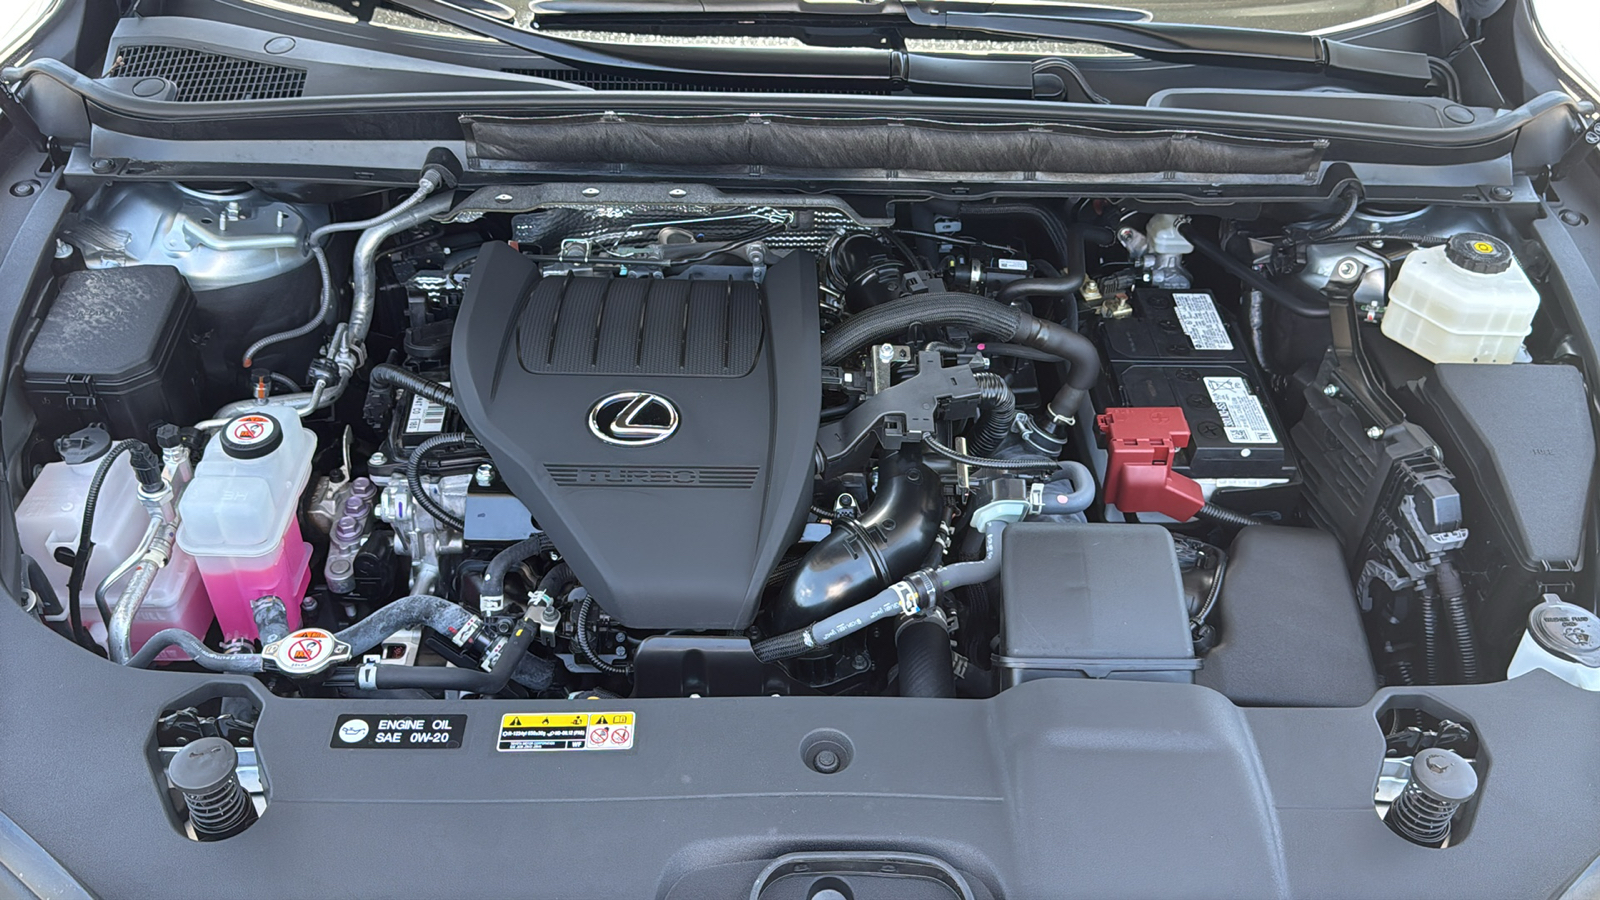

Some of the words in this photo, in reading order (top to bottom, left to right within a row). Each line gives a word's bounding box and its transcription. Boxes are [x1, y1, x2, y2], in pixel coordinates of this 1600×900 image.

[581, 469, 696, 483] TURBO
[135, 611, 166, 621] ULL
[378, 719, 425, 730] ENGINE
[432, 719, 452, 730] OIL
[375, 732, 402, 743] SAE
[410, 732, 449, 743] 0W-20
